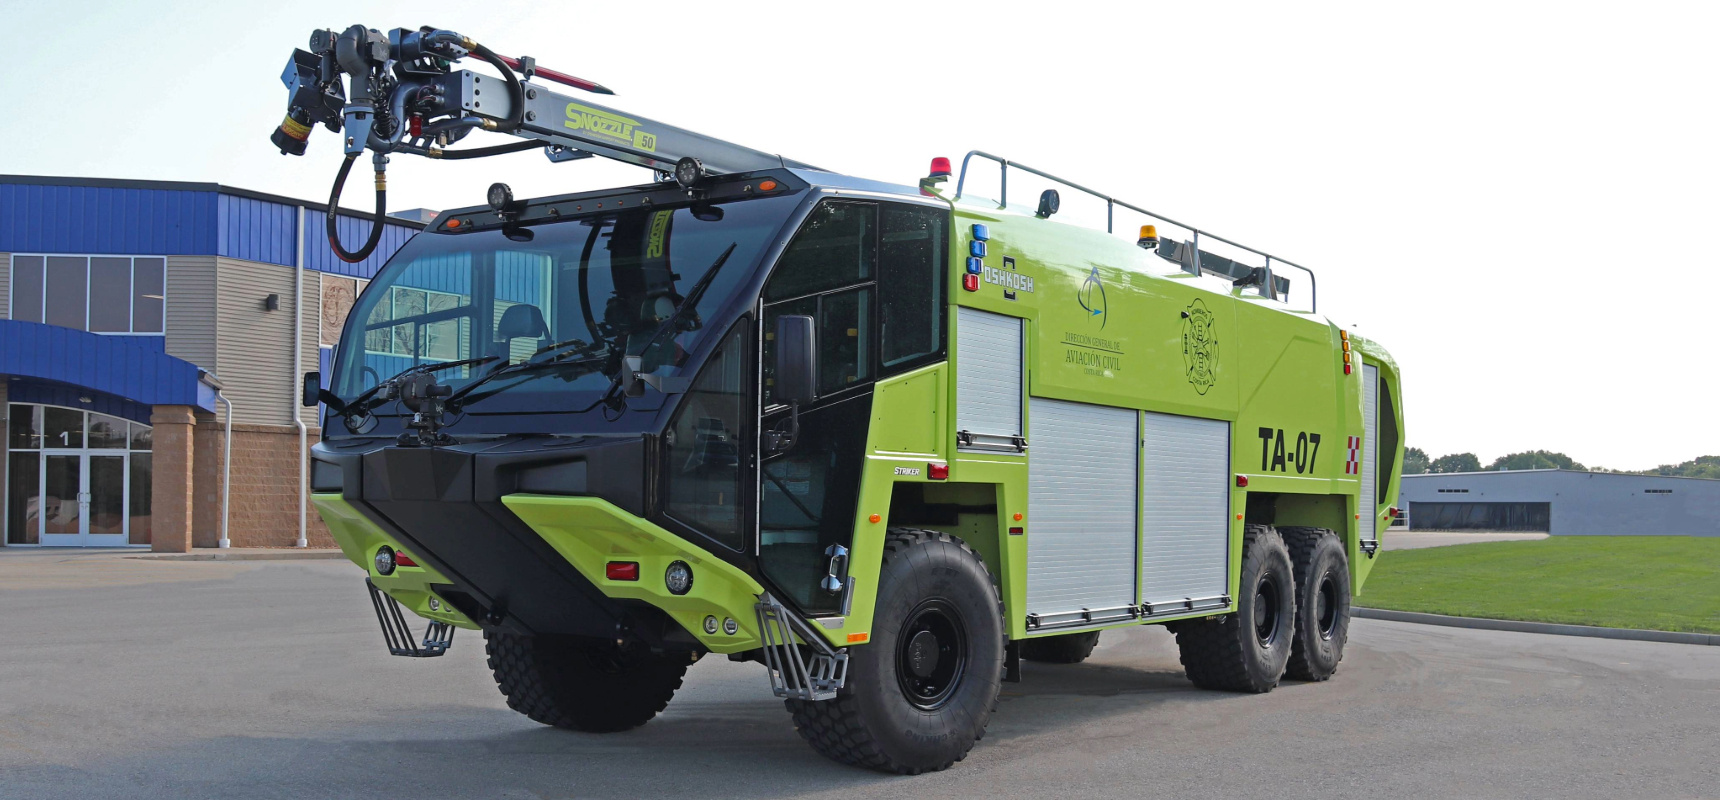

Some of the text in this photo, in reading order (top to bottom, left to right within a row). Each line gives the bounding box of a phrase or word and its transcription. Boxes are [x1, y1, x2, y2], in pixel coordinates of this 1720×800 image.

[641, 136, 654, 149] 50
[984, 265, 1034, 293] OSHKOSH
[1065, 332, 1120, 350] DIRECCIÓN GENERAL DE
[1065, 349, 1121, 370] AVIACIÓN CIVIL
[59, 431, 69, 446] 1
[1259, 427, 1321, 474] TA-07
[895, 466, 920, 475] STRIKER
